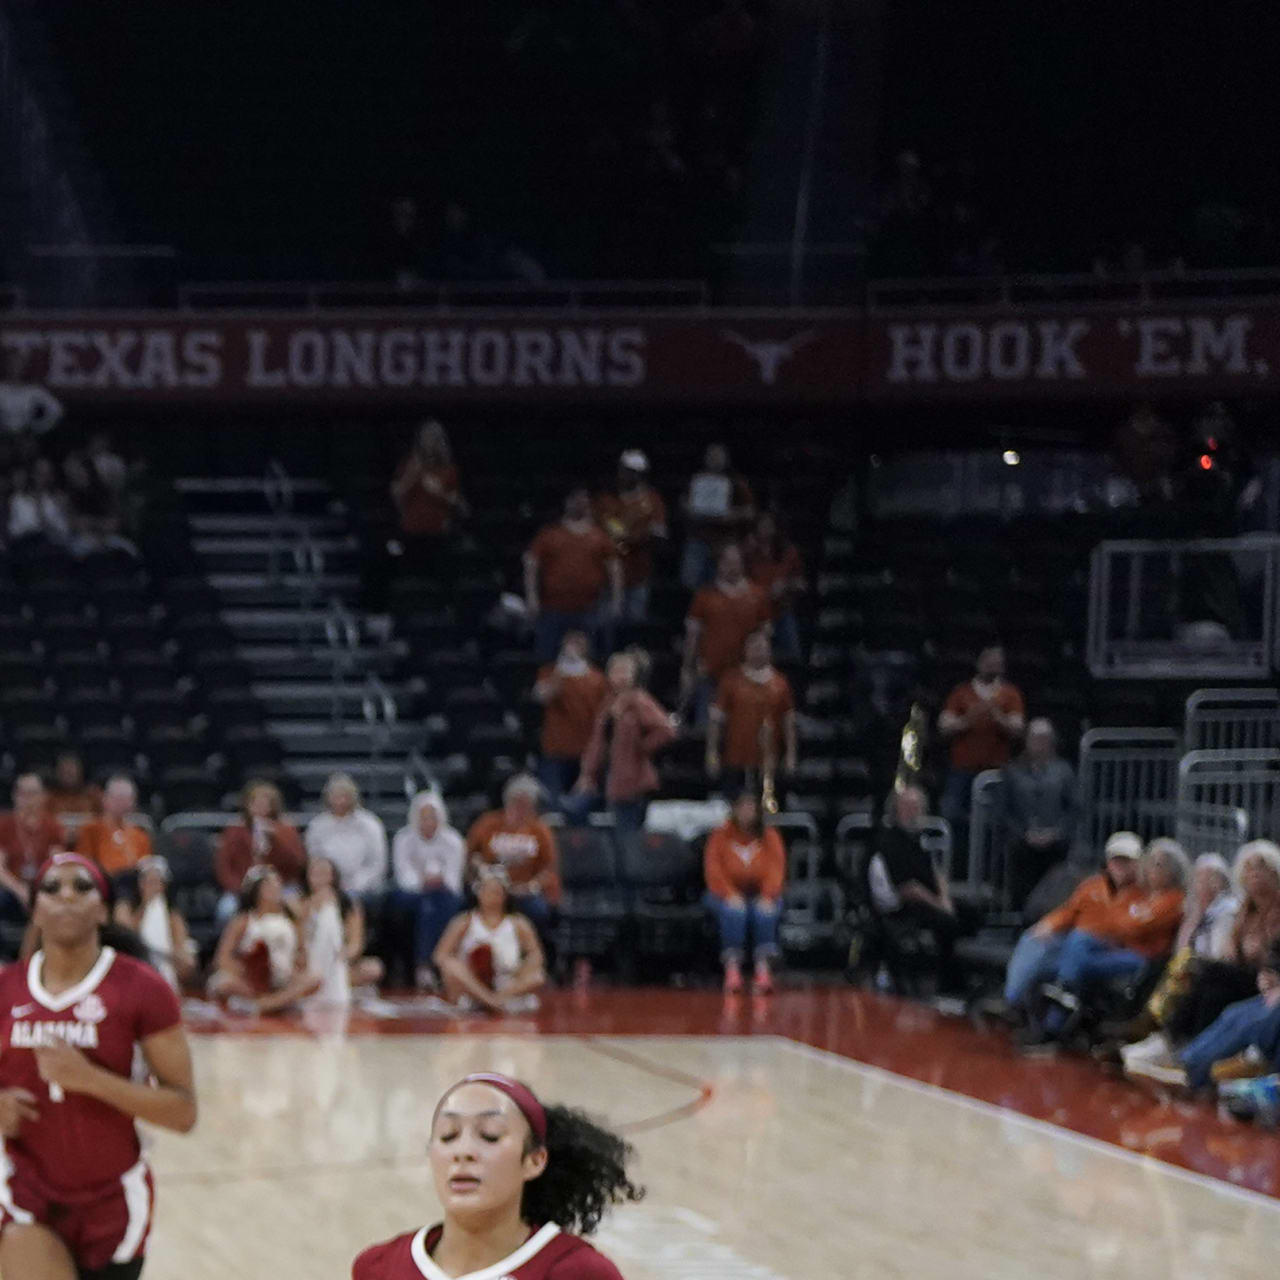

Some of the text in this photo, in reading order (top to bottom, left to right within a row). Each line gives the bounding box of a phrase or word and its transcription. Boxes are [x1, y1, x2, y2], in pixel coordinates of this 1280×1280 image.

[0, 328, 223, 388] TEXAS
[245, 328, 646, 388] LONGHORNS
[886, 320, 1090, 382] HOOK
